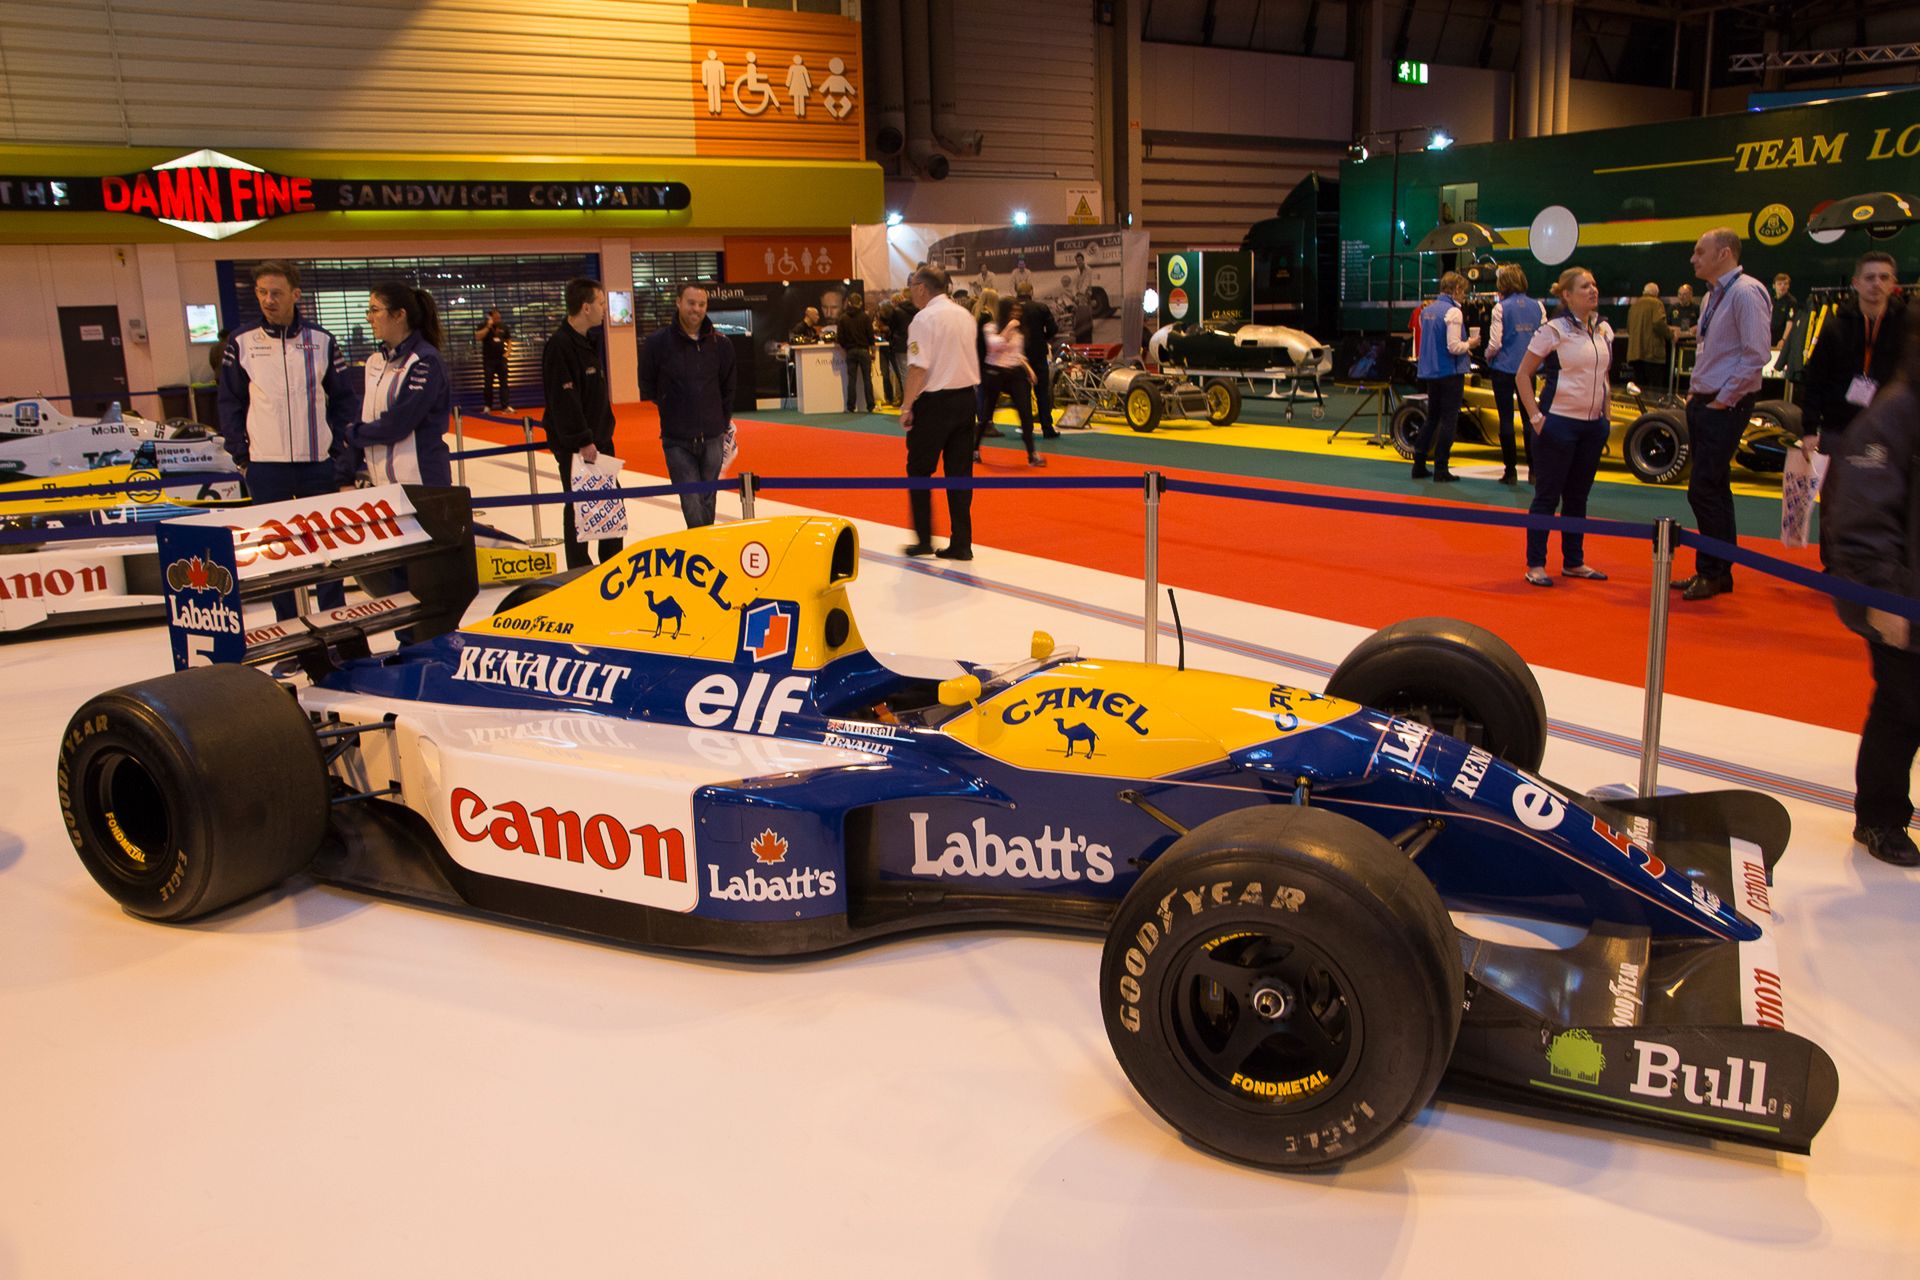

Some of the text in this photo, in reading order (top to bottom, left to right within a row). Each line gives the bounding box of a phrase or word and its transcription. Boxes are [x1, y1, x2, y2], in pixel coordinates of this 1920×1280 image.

[1735, 132, 1848, 172] TEAM
[0, 167, 670, 223] THE DAMN FINE SANDWICH COMPANY
[706, 287, 745, 300] algam
[91, 425, 125, 436] Mobil
[157, 447, 191, 457] niques
[182, 454, 214, 464] Garde
[222, 499, 404, 568] Canon
[490, 553, 553, 576] Tactel
[600, 547, 731, 611] CAMEL
[749, 552, 761, 569] E
[0, 565, 107, 600] non
[169, 594, 240, 635] Labatt's
[331, 598, 397, 622] Canon
[493, 616, 574, 635] GOODYEAR
[187, 634, 215, 667] 5
[451, 646, 631, 704] RENAULT
[685, 672, 811, 735] elf
[1001, 687, 1149, 736] CAMEL
[822, 733, 893, 756] RENAULT
[843, 720, 896, 738] Mansell
[105, 811, 146, 863] FONDMETAL
[451, 787, 687, 883] Canon
[909, 812, 1114, 884] Labatt's
[1591, 815, 1666, 880] 5
[708, 863, 836, 902] Labatt's
[1743, 861, 1771, 914] Canon
[1119, 881, 1306, 1034] GOODYEAR
[1609, 963, 1643, 1028] OODYEAR
[1753, 967, 1785, 1031] non
[1230, 1070, 1330, 1097] FONDMETAL
[1629, 1040, 1767, 1115] Bull
